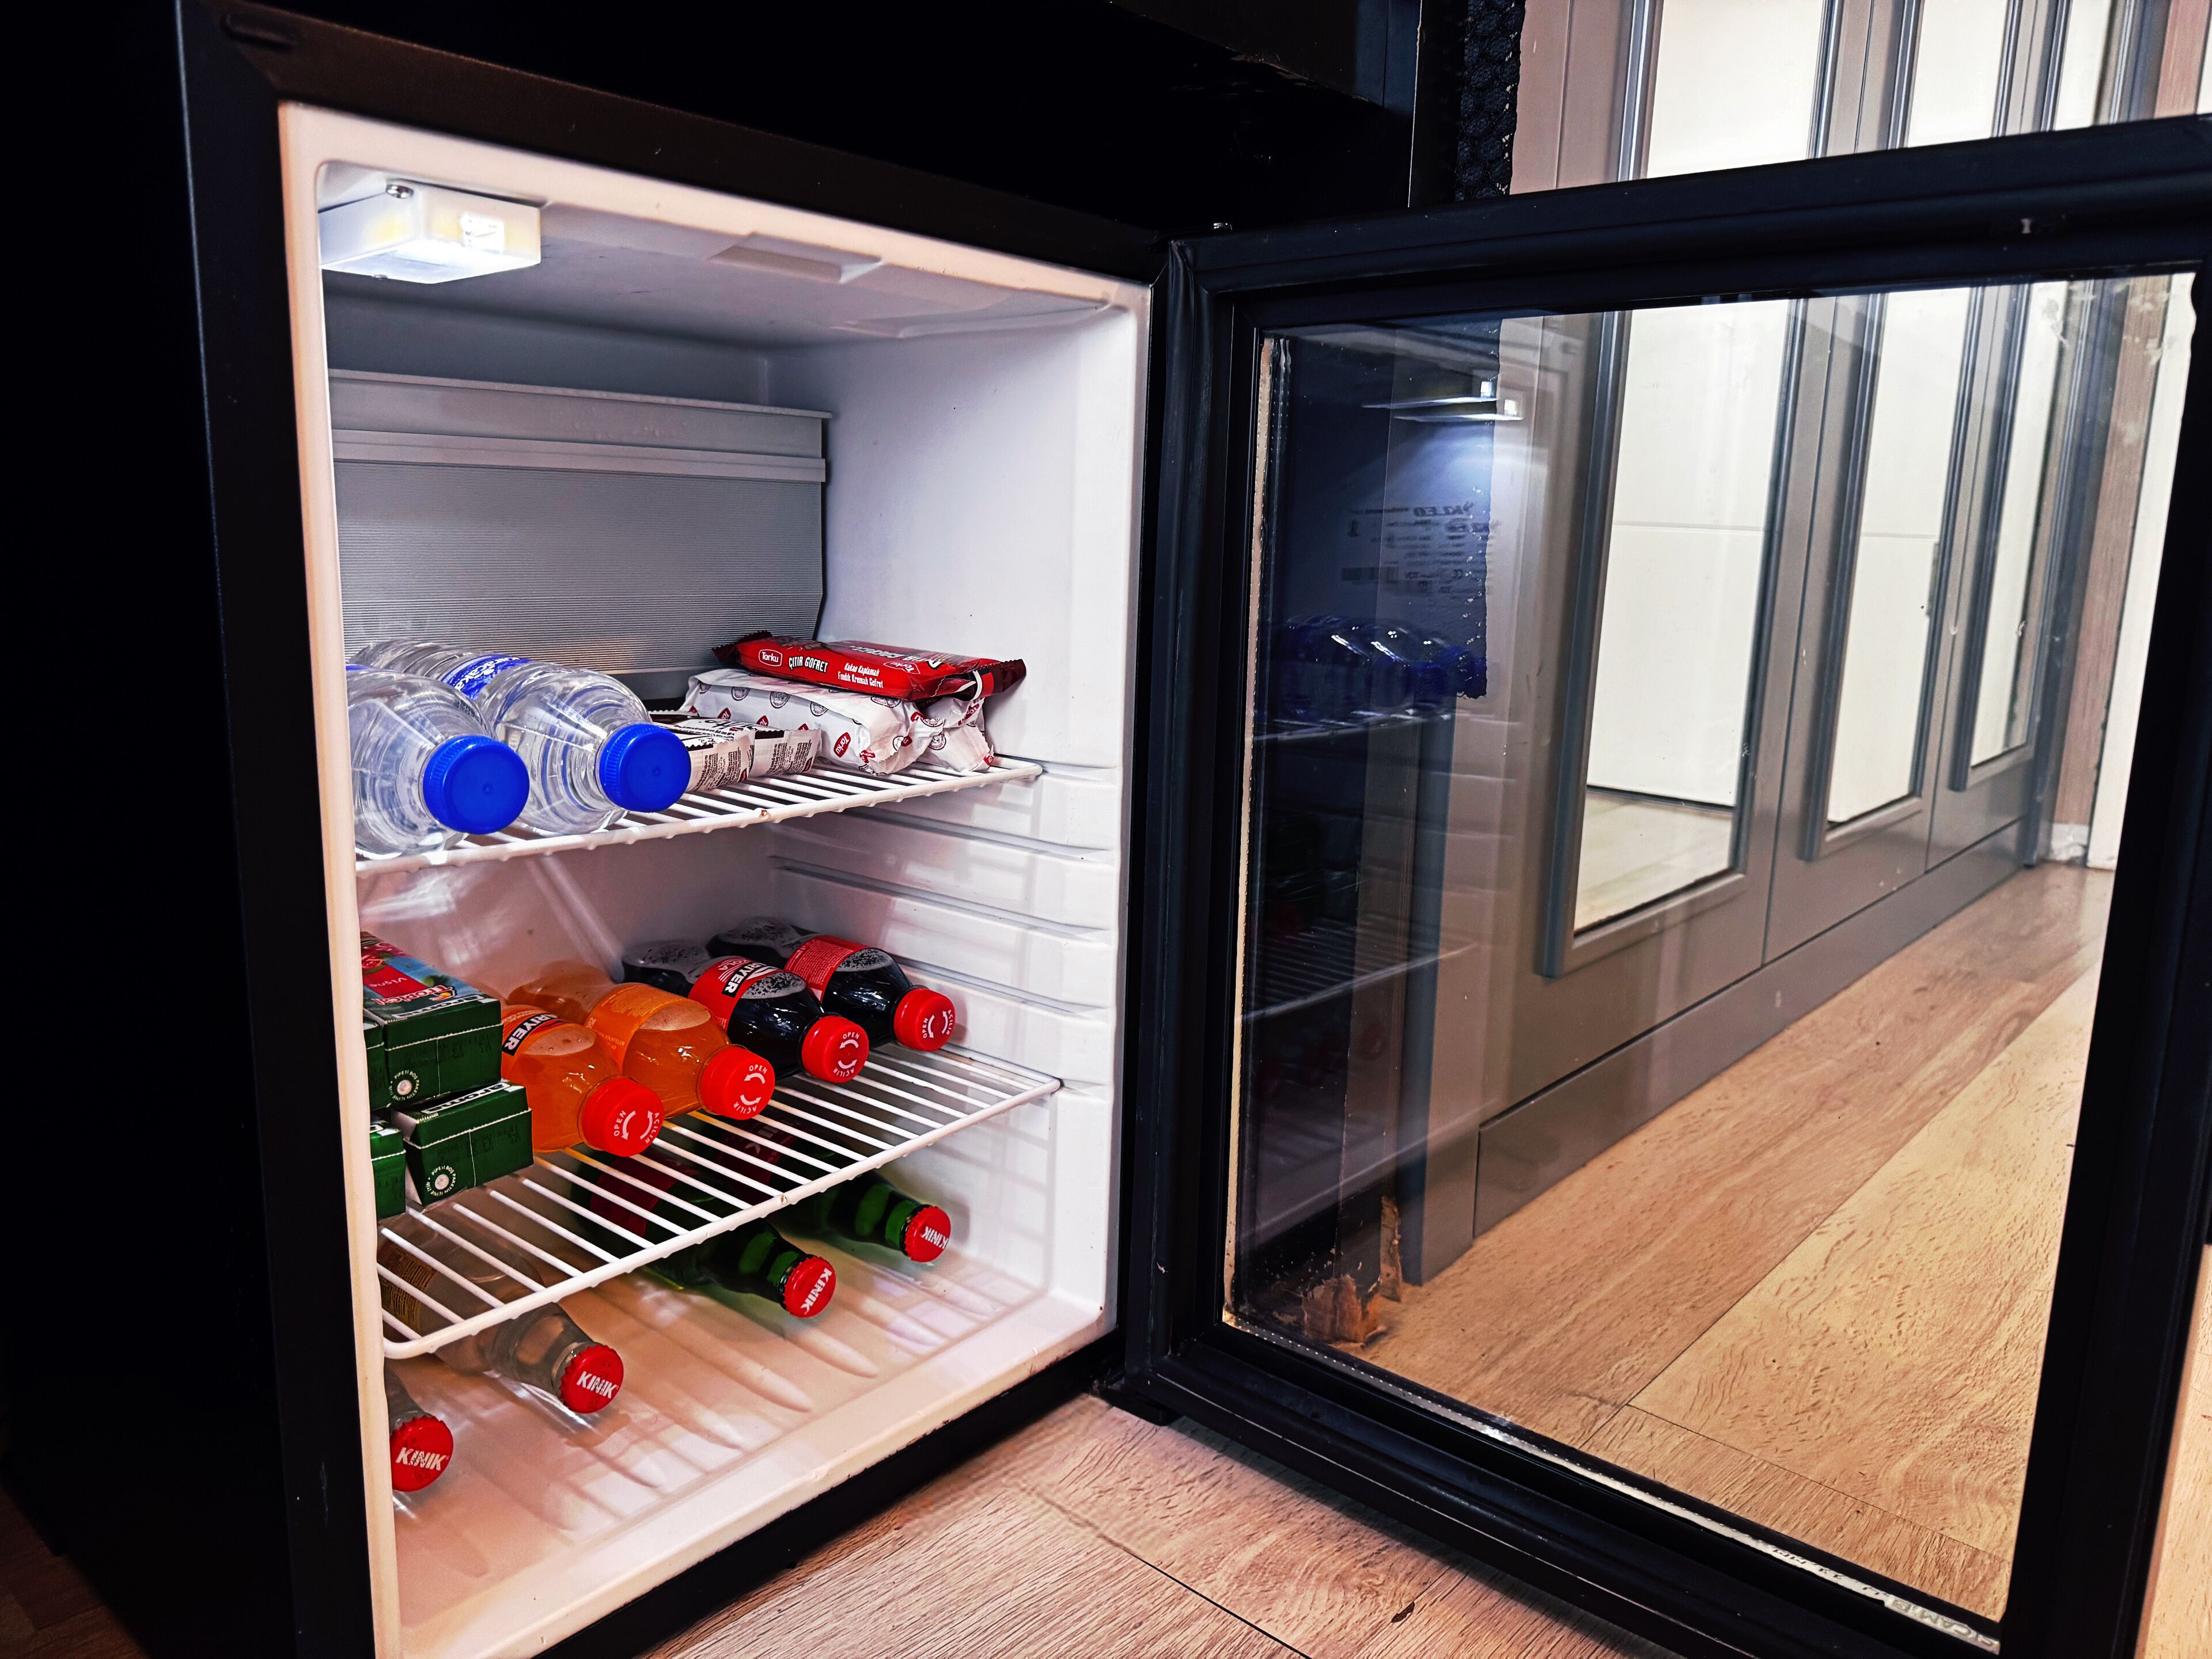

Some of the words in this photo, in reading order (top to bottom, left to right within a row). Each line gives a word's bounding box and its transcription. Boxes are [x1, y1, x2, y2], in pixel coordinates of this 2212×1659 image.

[762, 652, 779, 662] Torku
[789, 656, 804, 670] ÇITIR
[805, 657, 828, 673] GOFRET
[844, 662, 858, 673] Kakao
[890, 662, 915, 673] Torku
[869, 677, 884, 689] Gofret
[835, 736, 850, 754] Torku
[749, 1065, 767, 1074] OPEN
[613, 1110, 626, 1137] OPEN
[921, 1226, 948, 1249] KINIK
[800, 1267, 832, 1313] KINIK
[576, 1370, 618, 1399] KINIK
[395, 1446, 447, 1471] KINIK
